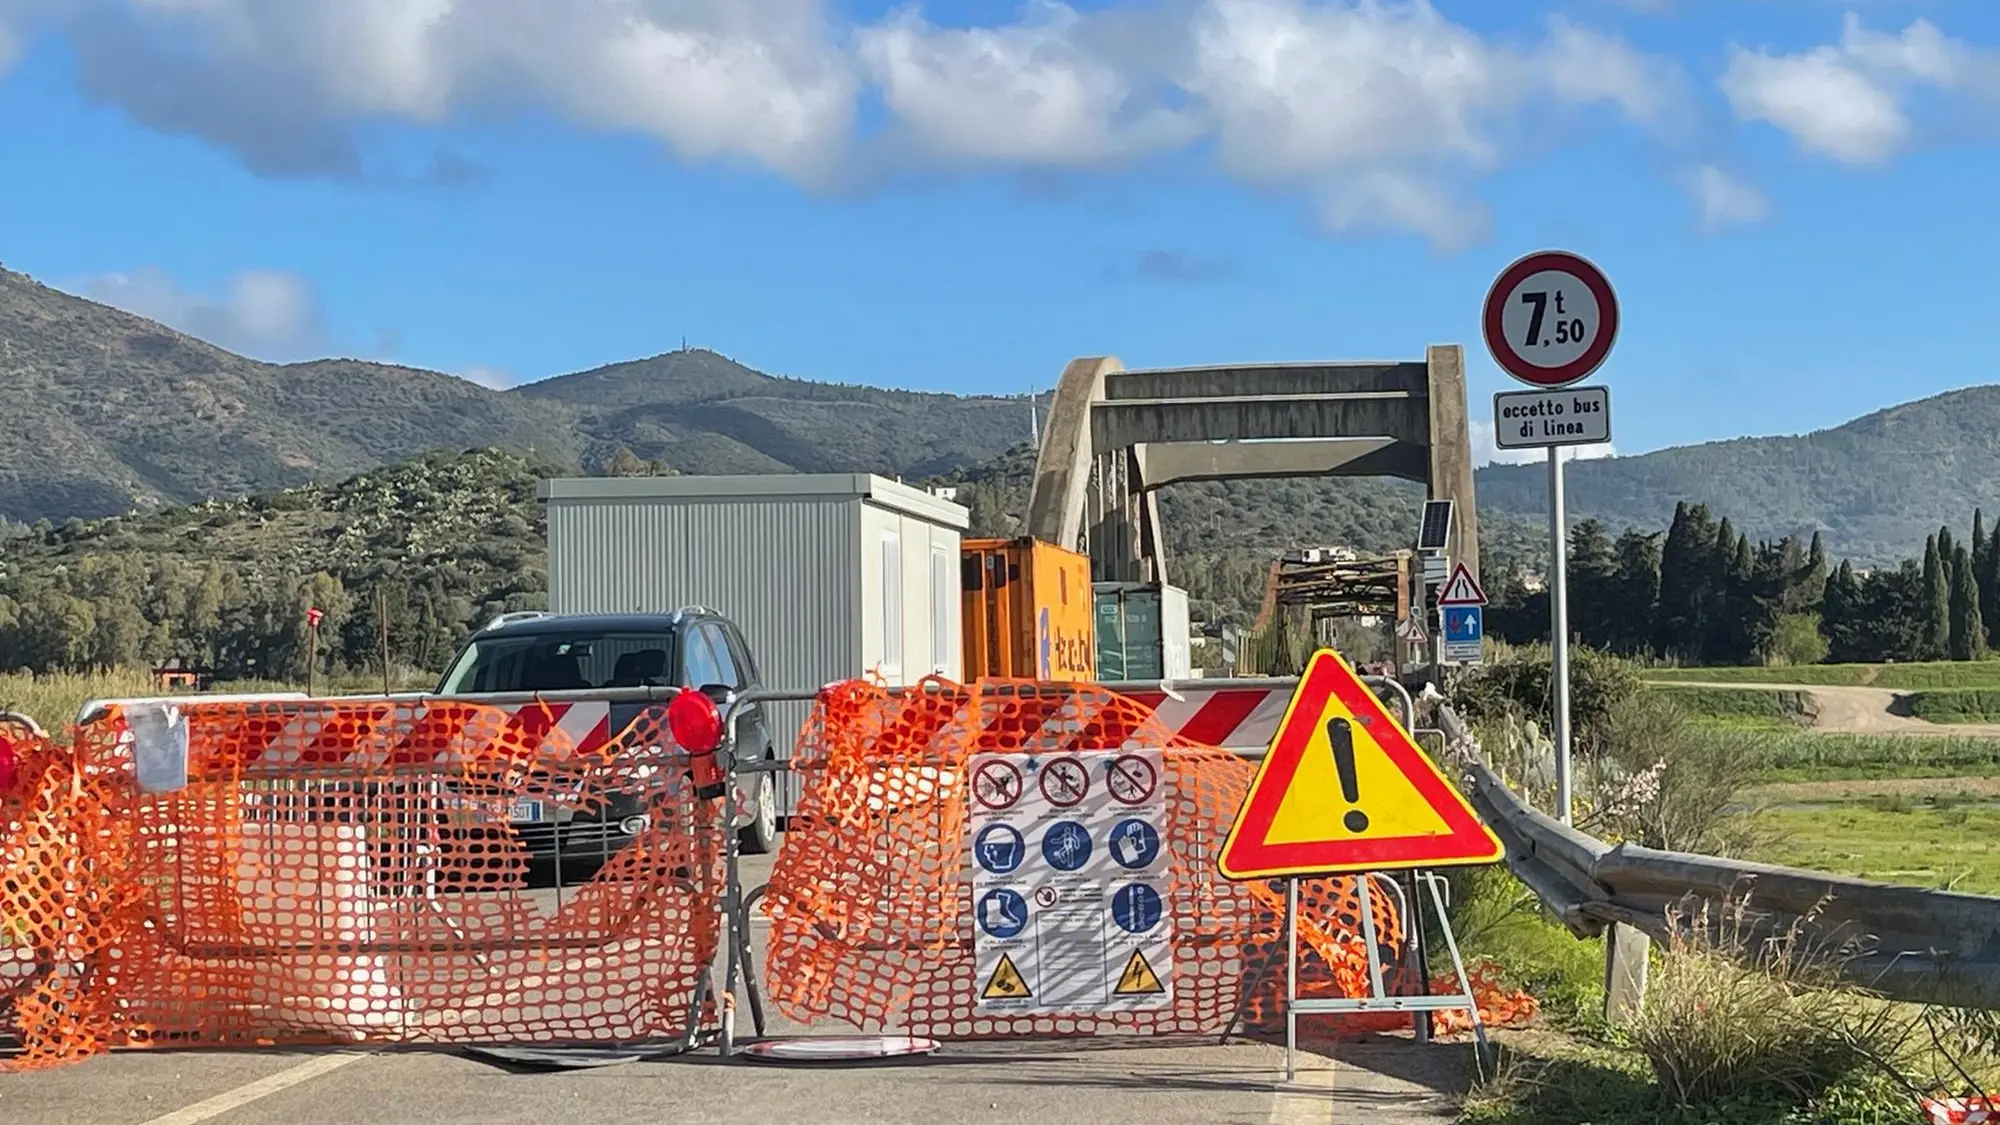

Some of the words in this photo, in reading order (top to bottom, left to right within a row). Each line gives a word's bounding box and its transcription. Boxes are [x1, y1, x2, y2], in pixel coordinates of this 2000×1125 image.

[1503, 400, 1564, 418] eccetto
[1573, 397, 1600, 414] bus
[1519, 420, 1534, 437] di
[1544, 419, 1584, 437] linea
